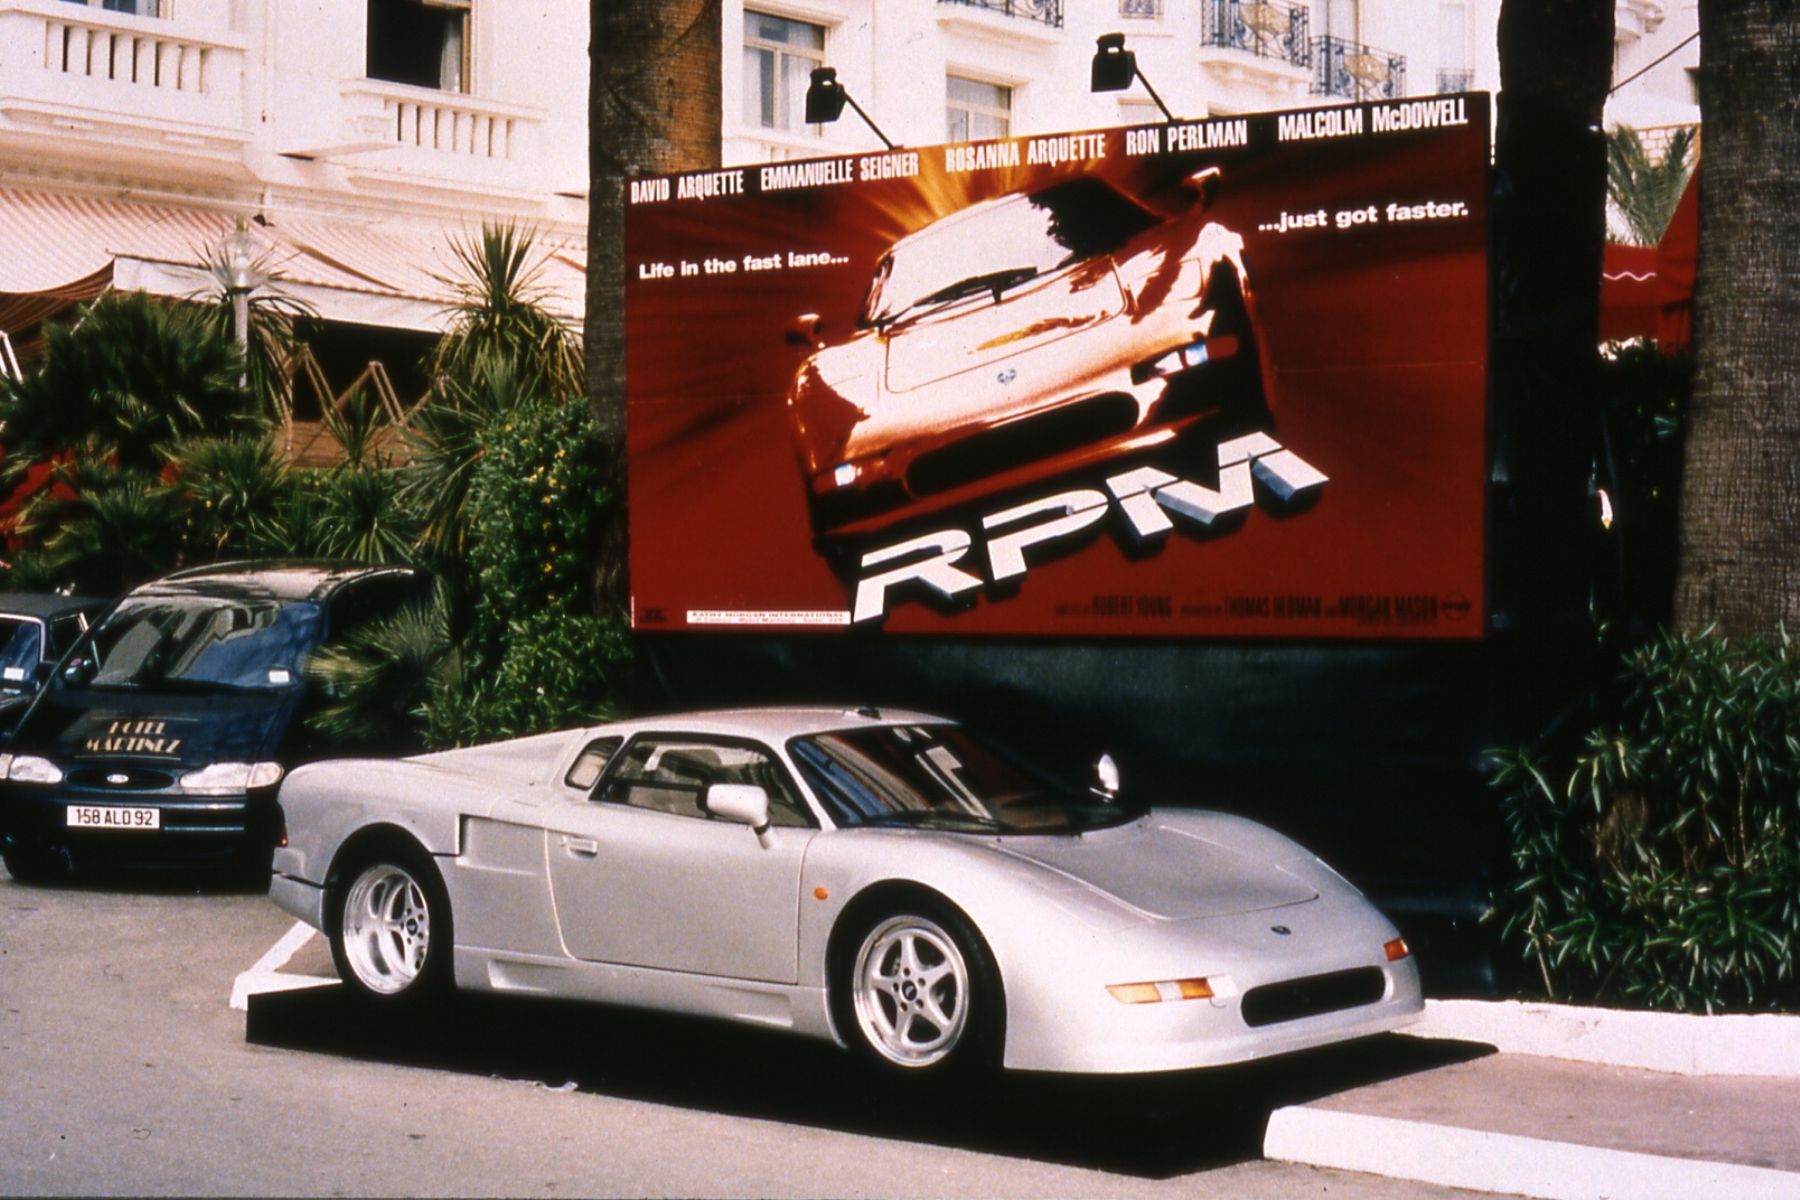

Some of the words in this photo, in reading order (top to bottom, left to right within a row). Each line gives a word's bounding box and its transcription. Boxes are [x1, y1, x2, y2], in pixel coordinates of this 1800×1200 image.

[630, 179, 670, 205] DAVID
[677, 170, 744, 201] ARQUETTE
[760, 160, 854, 192] EMMANUELLE
[860, 152, 919, 182] SEIGNER
[945, 142, 1021, 174] ROSANNA
[1027, 133, 1106, 167] ARQUETTE
[1126, 128, 1160, 156] RON
[1167, 120, 1248, 153] PERLMAN
[1278, 108, 1363, 142] MALCOLM
[1371, 98, 1469, 134] McDOWELL
[1258, 209, 1328, 234] ...just
[1335, 205, 1378, 229] got
[1385, 200, 1469, 222] faster.
[639, 262, 675, 280] Life
[680, 260, 699, 277] in
[703, 257, 737, 275] the
[742, 253, 782, 271] fast
[787, 250, 850, 269] lane...
[853, 431, 1330, 623] RPM
[76, 808, 100, 825] 158
[134, 810, 153, 827] 92
